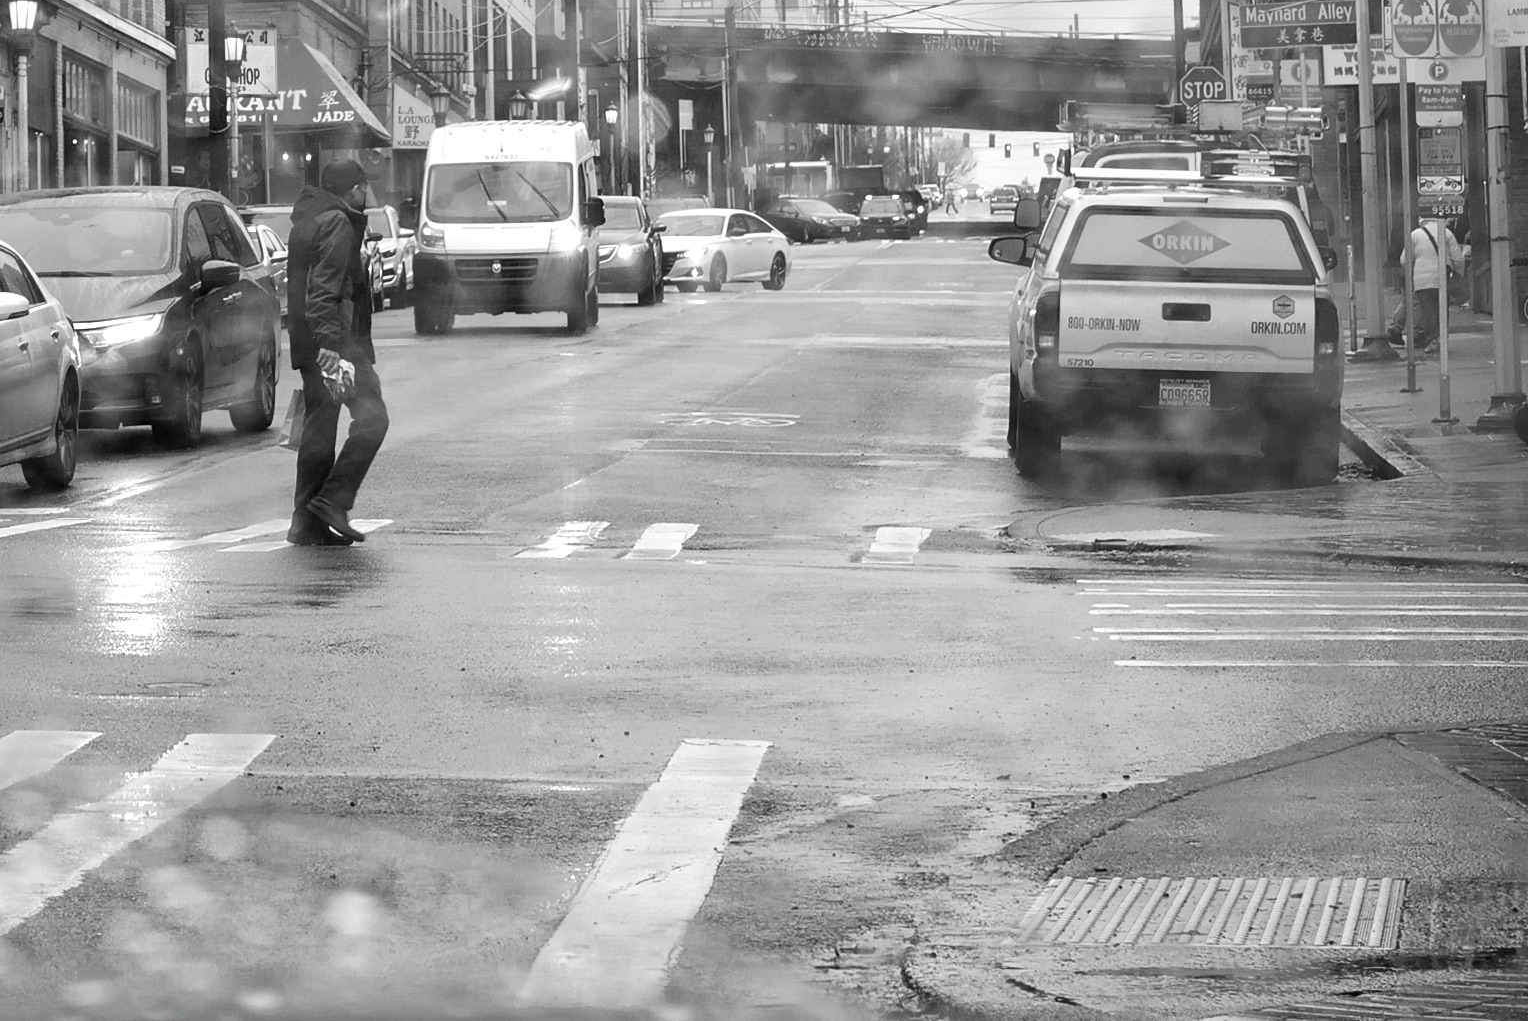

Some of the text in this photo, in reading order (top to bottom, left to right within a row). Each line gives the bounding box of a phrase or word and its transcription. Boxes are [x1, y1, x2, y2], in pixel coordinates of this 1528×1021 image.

[1245, 3, 1353, 25] Maynard Alley
[236, 67, 261, 85] HOP
[1184, 81, 1224, 99] STOP
[1418, 86, 1433, 95] Pay
[1442, 86, 1460, 94] Park
[312, 110, 355, 123] JADE
[1431, 205, 1464, 215] 95518
[1152, 233, 1214, 252] ORKIN
[1067, 316, 1141, 332] 800-ORKIN-NOW
[1251, 321, 1306, 335] ORKIN.COM
[1067, 359, 1094, 367] 57210
[1114, 350, 1262, 363] TACOMA
